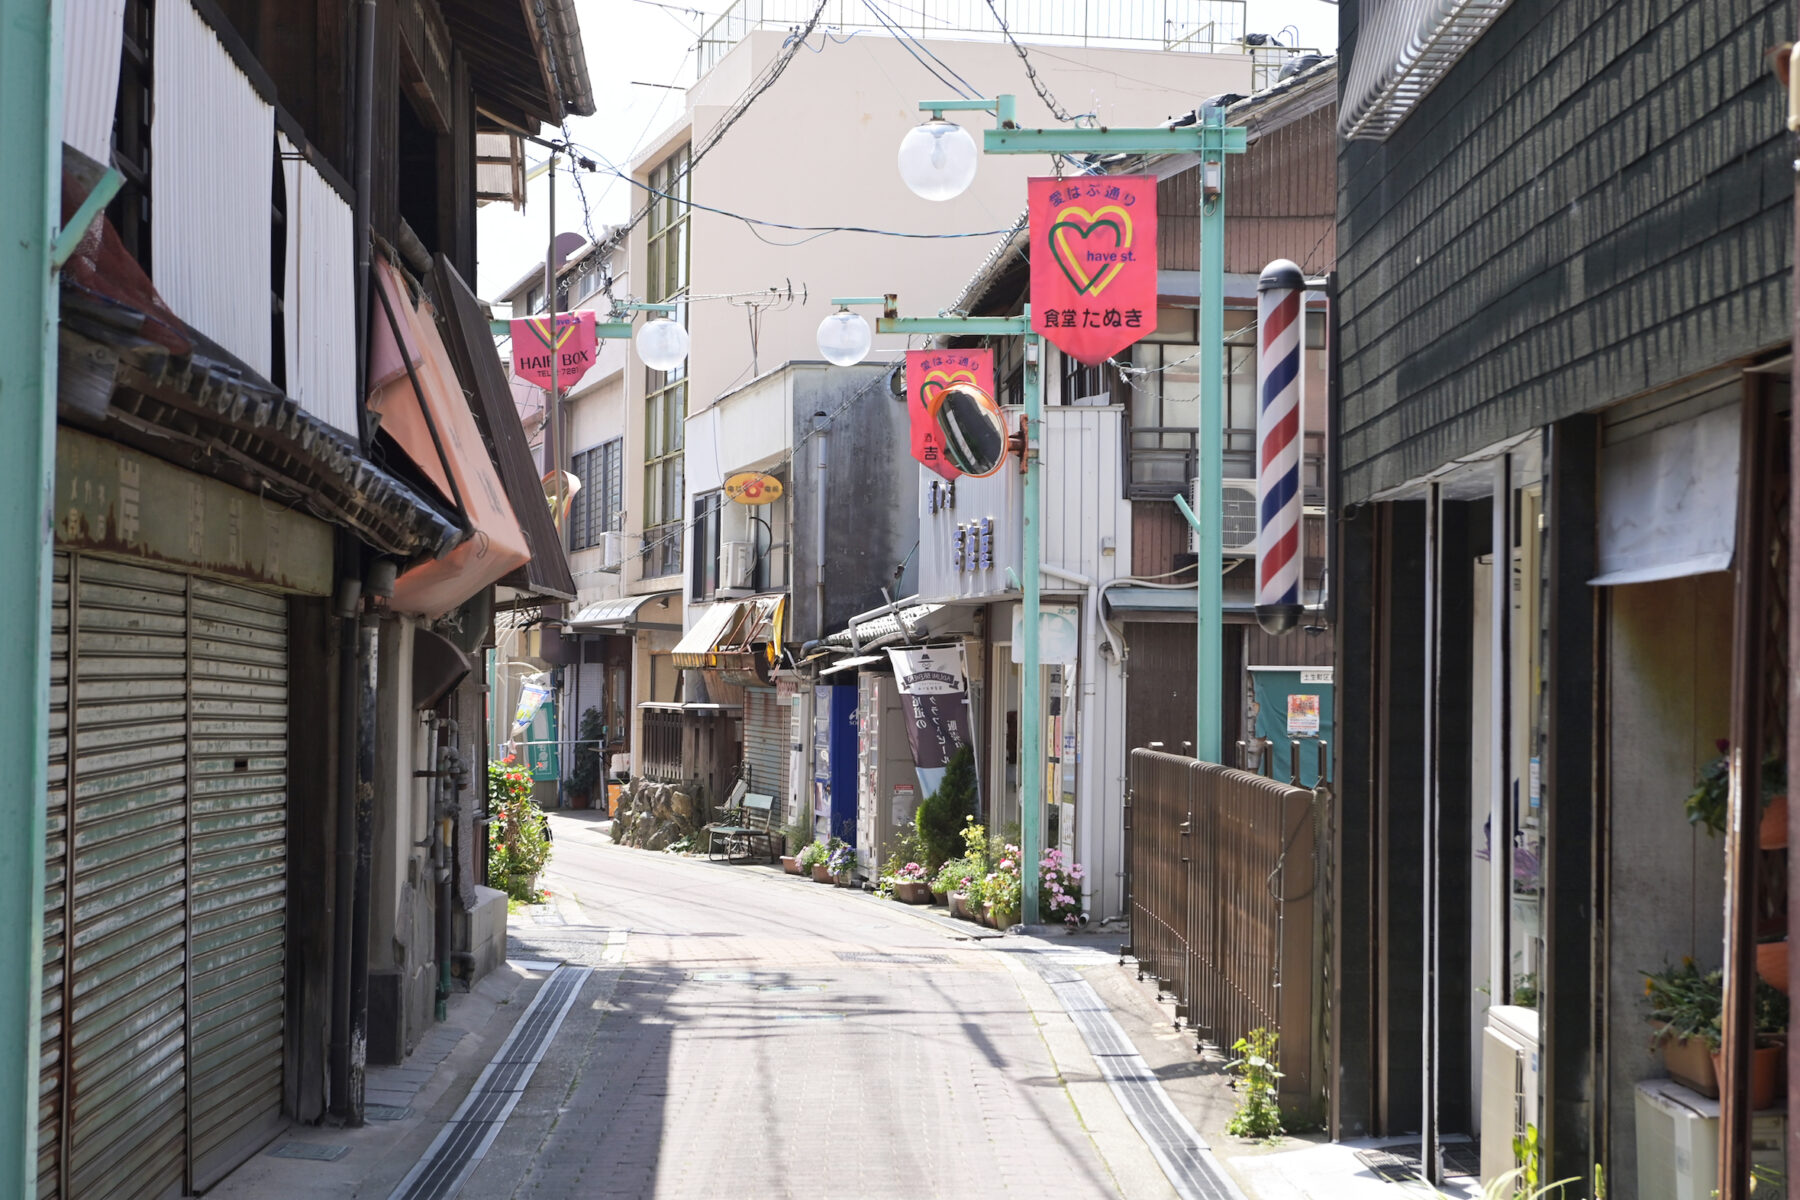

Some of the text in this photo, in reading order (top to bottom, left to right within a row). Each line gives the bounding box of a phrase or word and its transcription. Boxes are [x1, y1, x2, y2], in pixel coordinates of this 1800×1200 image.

[1049, 184, 1136, 207] 愛はぶ通り
[1086, 251, 1136, 262] have st.
[1044, 308, 1143, 328] 食堂 たぬき
[562, 350, 589, 366] BOX
[920, 354, 980, 372] 愛はぶ通り
